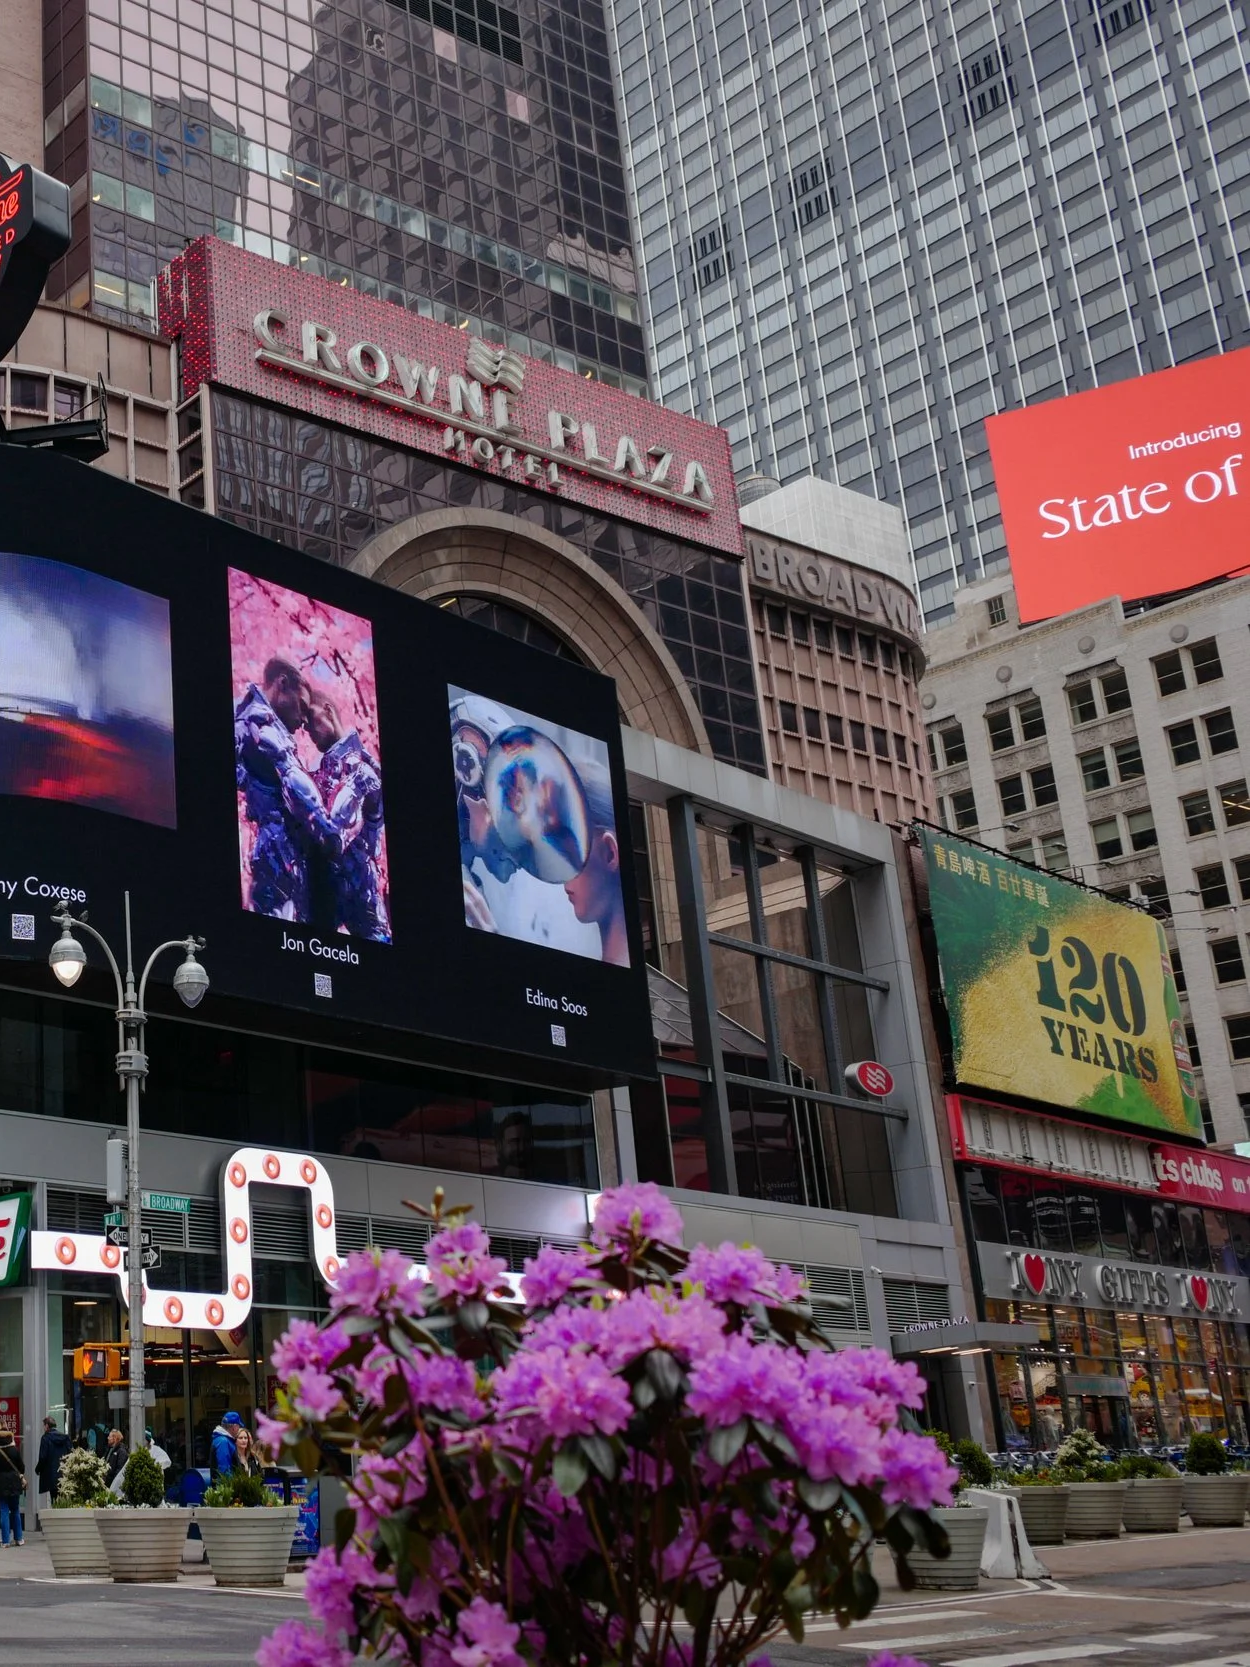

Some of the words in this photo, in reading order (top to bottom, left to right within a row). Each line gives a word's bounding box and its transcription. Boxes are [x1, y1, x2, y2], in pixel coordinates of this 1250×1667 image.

[253, 307, 523, 436] CROWNE
[548, 410, 715, 501] PLAZA
[444, 425, 566, 489] HOTEL
[1129, 422, 1241, 459] Introducing
[1038, 482, 1171, 539] State
[1185, 454, 1243, 502] of
[24, 876, 87, 903] Coxese
[281, 931, 304, 953] Jon
[309, 938, 359, 966] Gacela
[1028, 925, 1147, 1037] 120
[526, 987, 558, 1010] Edina
[561, 994, 588, 1017] Soos
[1041, 1016, 1159, 1083] YEARS
[1181, 1157, 1223, 1191] clubs
[1232, 1177, 1246, 1193] on
[151, 1194, 189, 1211] BROADWAY
[113, 1232, 127, 1241] ONE
[142, 1252, 155, 1262] WAY
[1006, 1252, 1026, 1292] I
[1045, 1257, 1088, 1299] NY
[1096, 1265, 1171, 1308] GIFTS
[1207, 1278, 1243, 1315] NY
[904, 1320, 939, 1334] CROWNE
[942, 1316, 970, 1328] PLAZA
